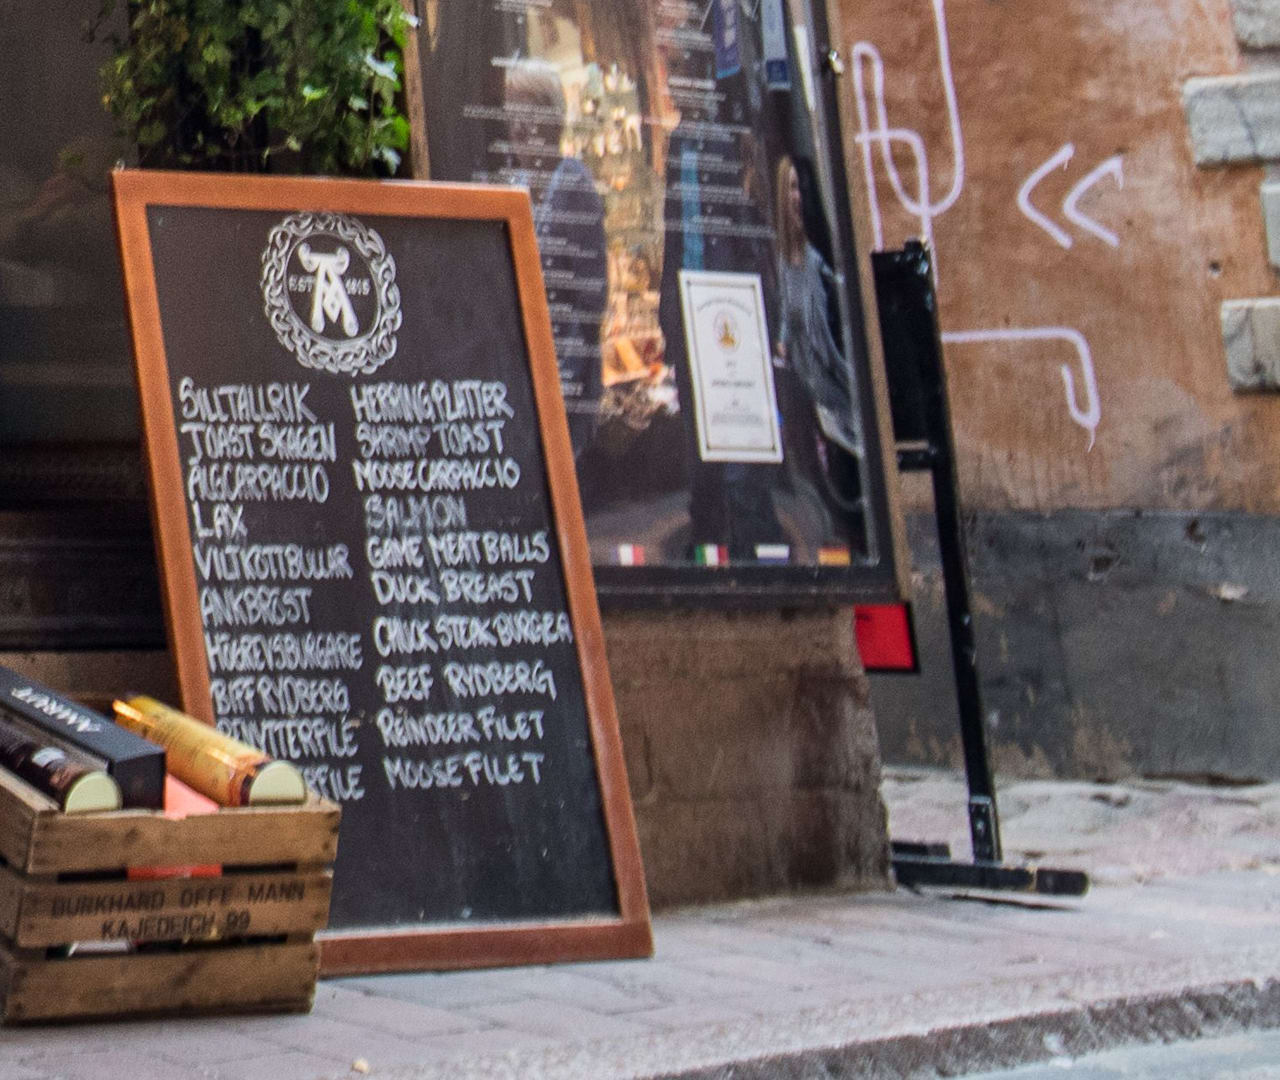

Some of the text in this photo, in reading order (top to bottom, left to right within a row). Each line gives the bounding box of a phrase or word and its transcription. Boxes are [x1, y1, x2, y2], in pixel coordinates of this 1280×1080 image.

[181, 422, 255, 465] TOAST
[433, 420, 505, 456] TOAST
[193, 500, 248, 539] LAX
[365, 494, 467, 529] SALMON
[371, 569, 535, 605] DUCK BREAST
[211, 675, 350, 715] BIFF RYDBERG
[377, 659, 557, 703] BEEF RYDBERG
[377, 705, 544, 748] REINDEER FILET
[383, 756, 464, 790] MOOSE
[464, 750, 545, 786] FILET
